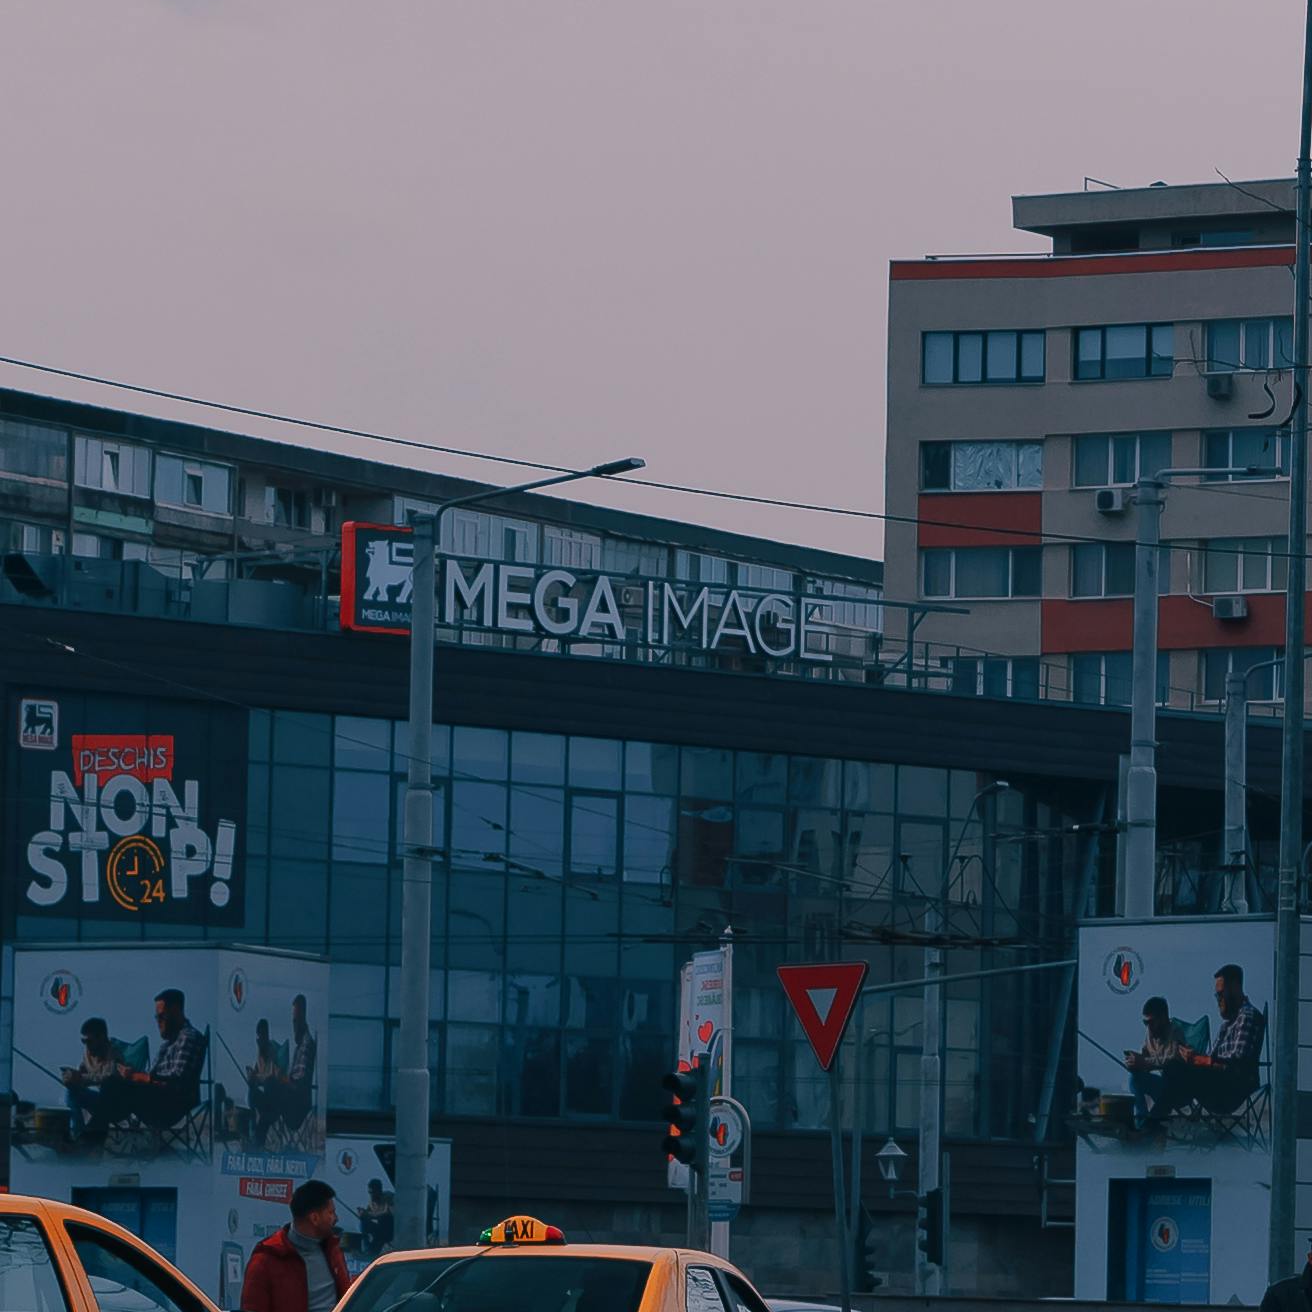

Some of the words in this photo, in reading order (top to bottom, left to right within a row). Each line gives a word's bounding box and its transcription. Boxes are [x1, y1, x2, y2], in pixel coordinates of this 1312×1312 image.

[362, 608, 391, 621] MEGA
[444, 559, 627, 639] MEGA
[646, 580, 833, 661] IMAGE
[80, 746, 169, 771] DESCHIS
[50, 770, 199, 838] NON
[139, 879, 166, 904] 24
[503, 1219, 534, 1240] TAXI
